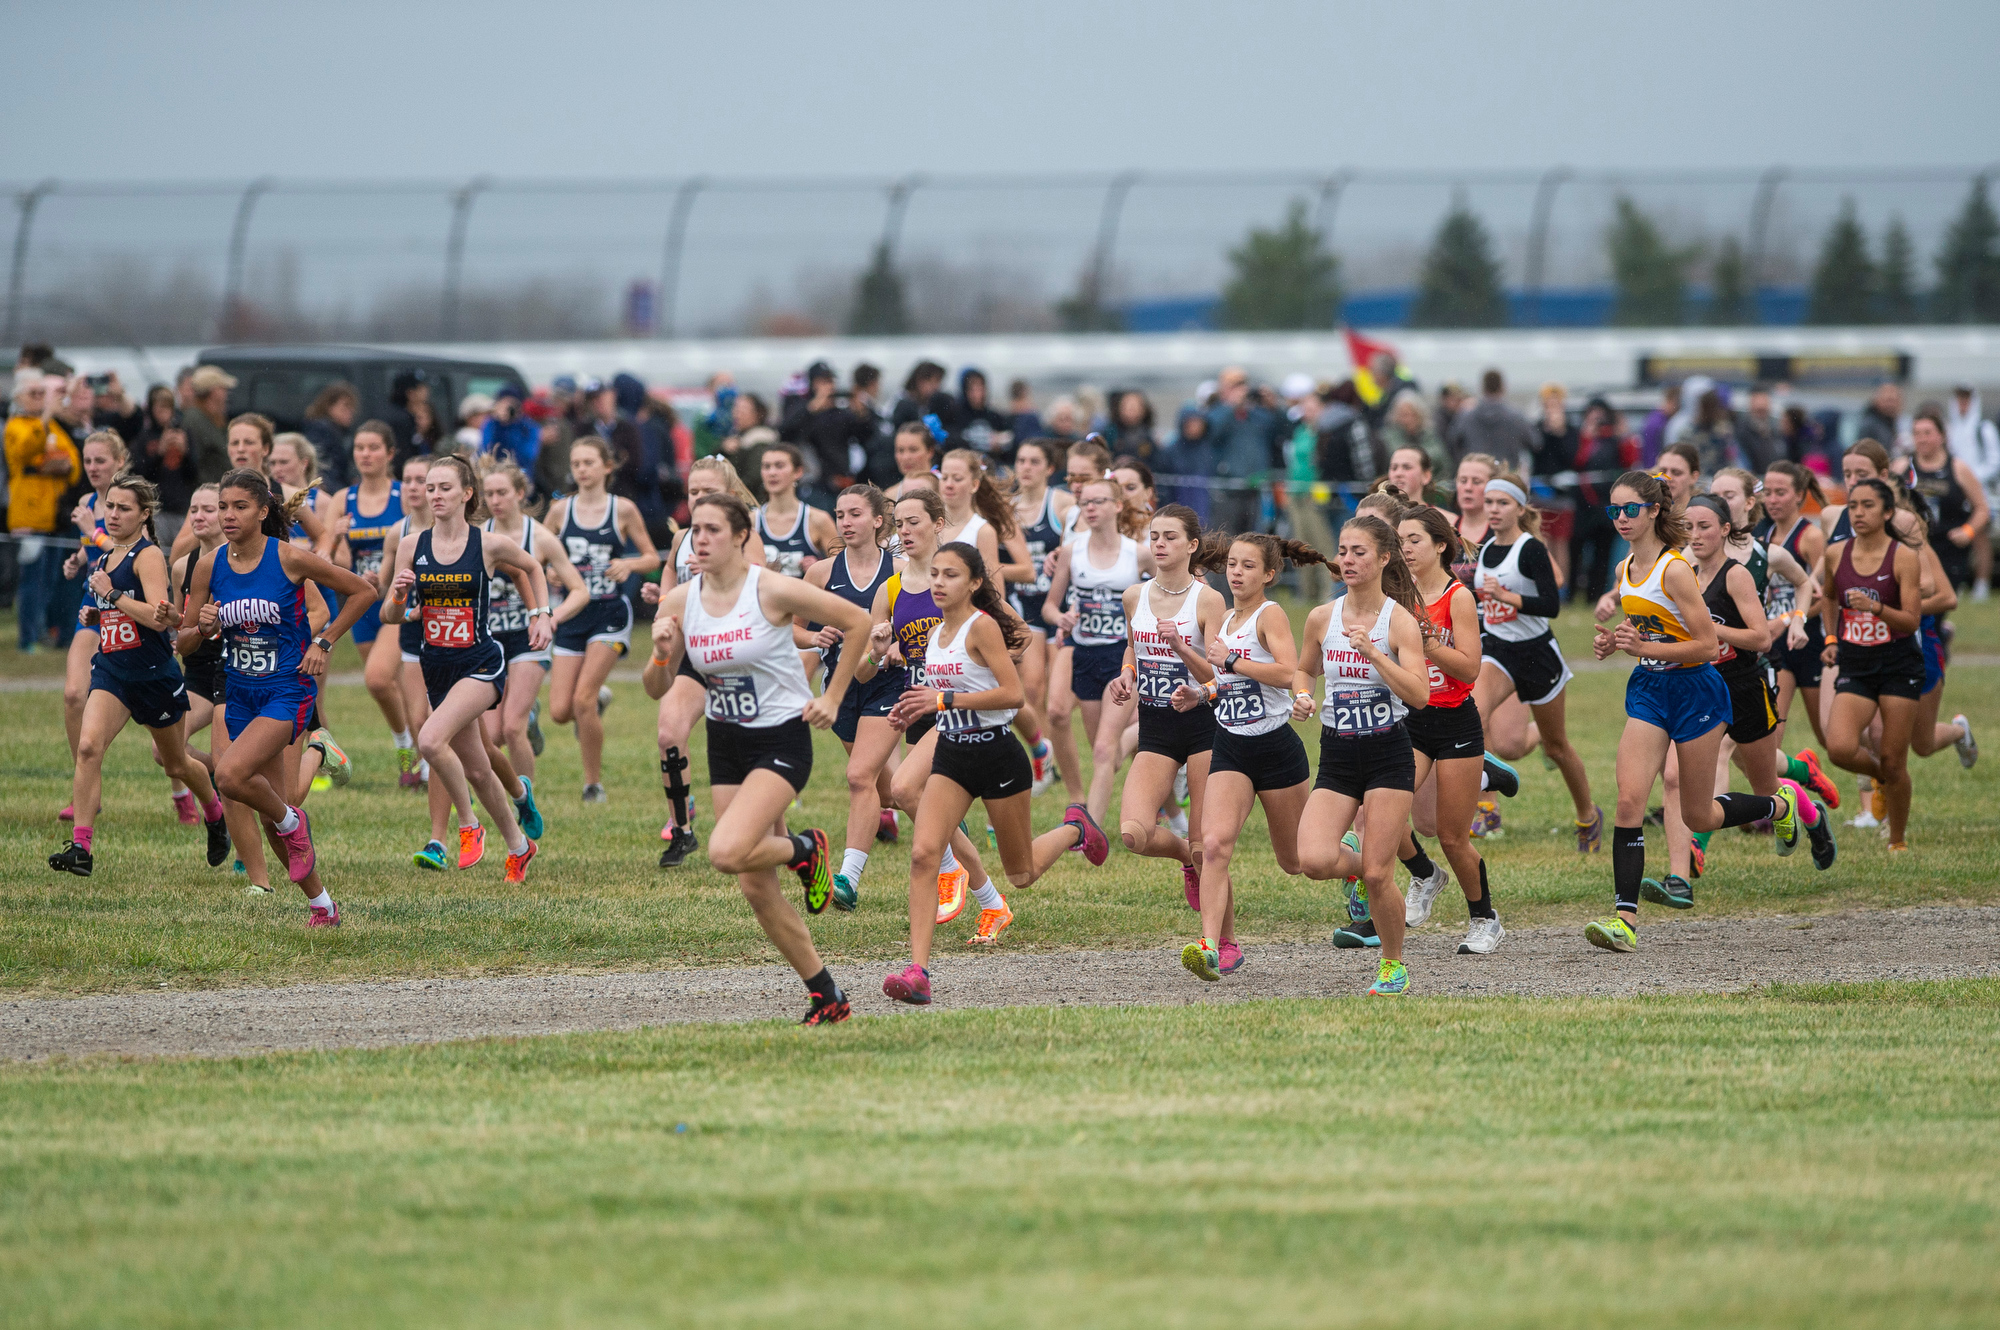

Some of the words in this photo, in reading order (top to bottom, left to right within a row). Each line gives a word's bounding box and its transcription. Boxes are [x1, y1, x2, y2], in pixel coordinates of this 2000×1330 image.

[420, 573, 472, 582] SACRED
[585, 576, 616, 594] 129
[219, 598, 281, 627] COUGARS
[425, 598, 472, 607] HEART
[101, 622, 136, 647] 978
[427, 620, 470, 641] 974
[900, 617, 945, 641] CONCOR
[1081, 613, 1125, 636] 2026
[1845, 621, 1889, 642] 1028
[689, 627, 753, 648] WHITMORE
[1134, 630, 1192, 647] WHITMRE
[232, 647, 276, 671] 1951
[704, 647, 734, 664] LAKE
[1146, 646, 1175, 658] LAKE
[909, 665, 927, 686] 19
[925, 663, 964, 676] HITMORE
[1339, 666, 1370, 679] LAKE
[931, 678, 955, 690] LAKE
[710, 689, 757, 716] 2118
[1220, 694, 1264, 720] 2123
[937, 708, 974, 731] 2117
[1336, 702, 1391, 730] 2119
[959, 732, 995, 743] PRO
